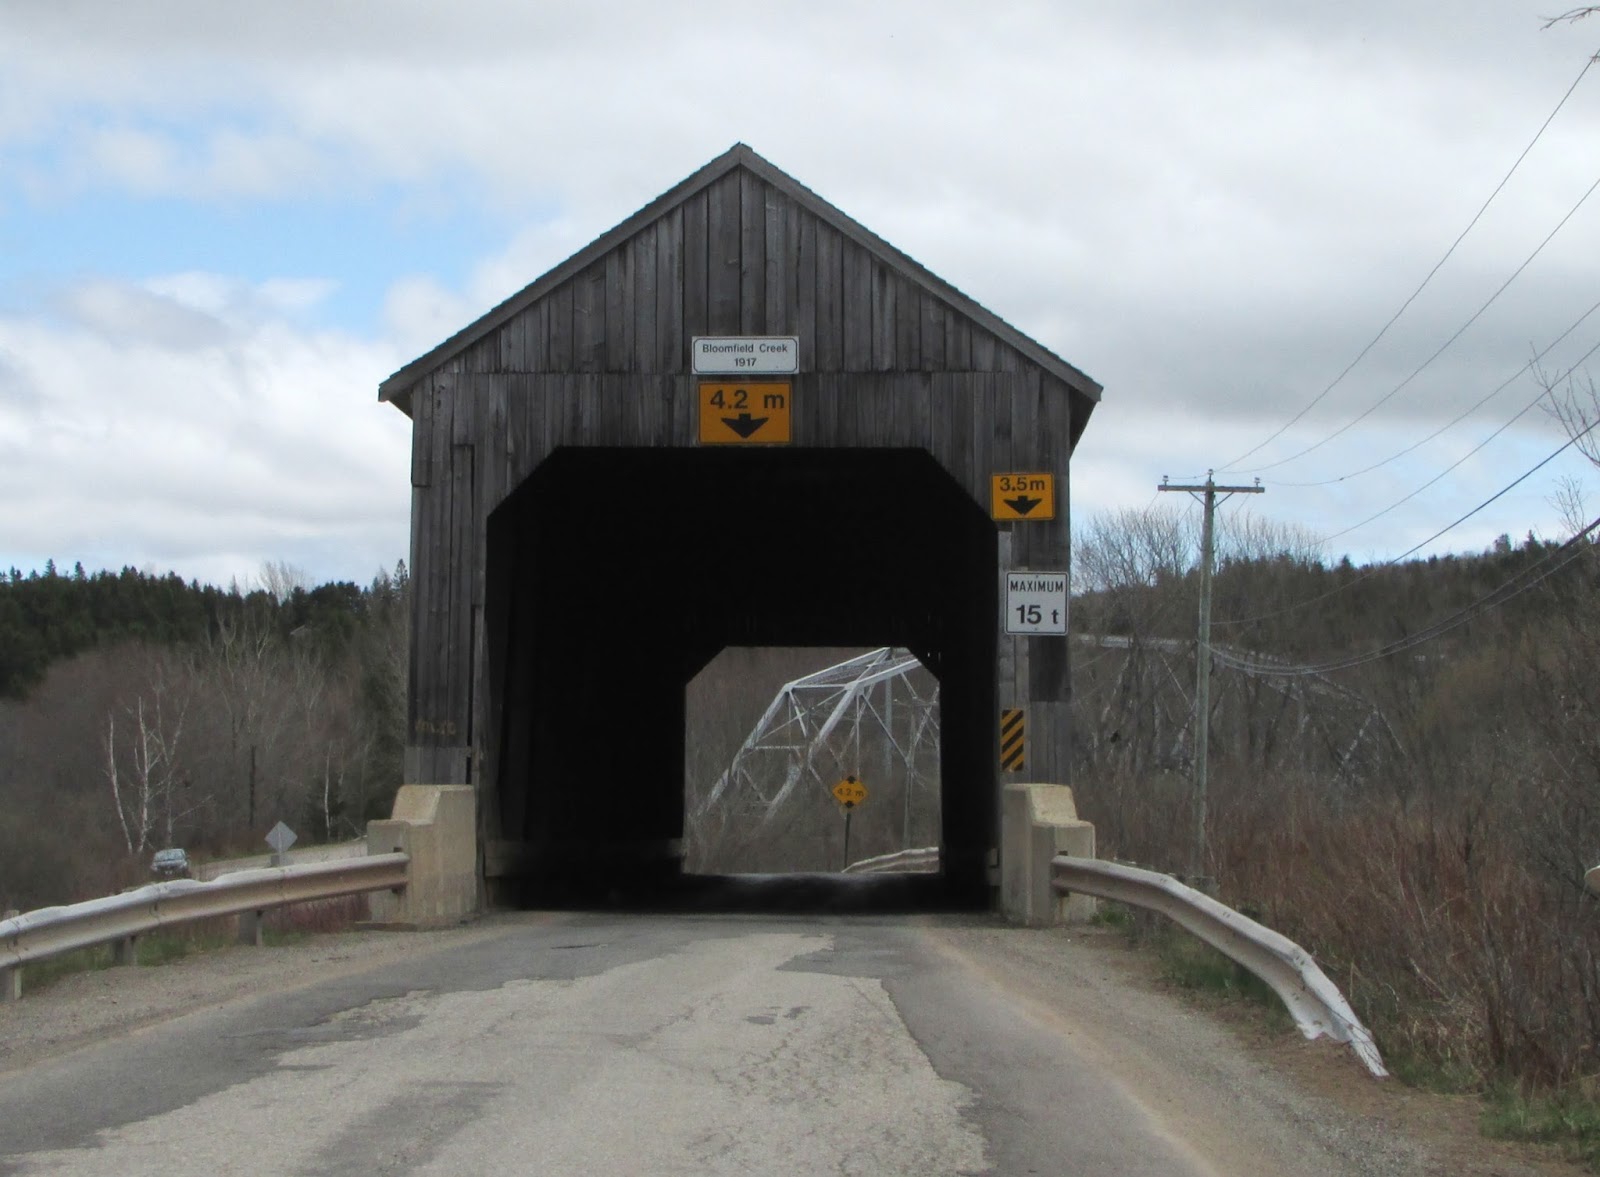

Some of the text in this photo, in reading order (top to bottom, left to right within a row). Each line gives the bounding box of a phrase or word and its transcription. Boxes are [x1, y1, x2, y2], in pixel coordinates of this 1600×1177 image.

[702, 343, 788, 353] Bloomfield Creek
[734, 357, 757, 367] 1917
[710, 389, 785, 409] 4.2 m
[1009, 580, 1064, 593] MAXIMUM
[1016, 604, 1059, 624] 15 t
